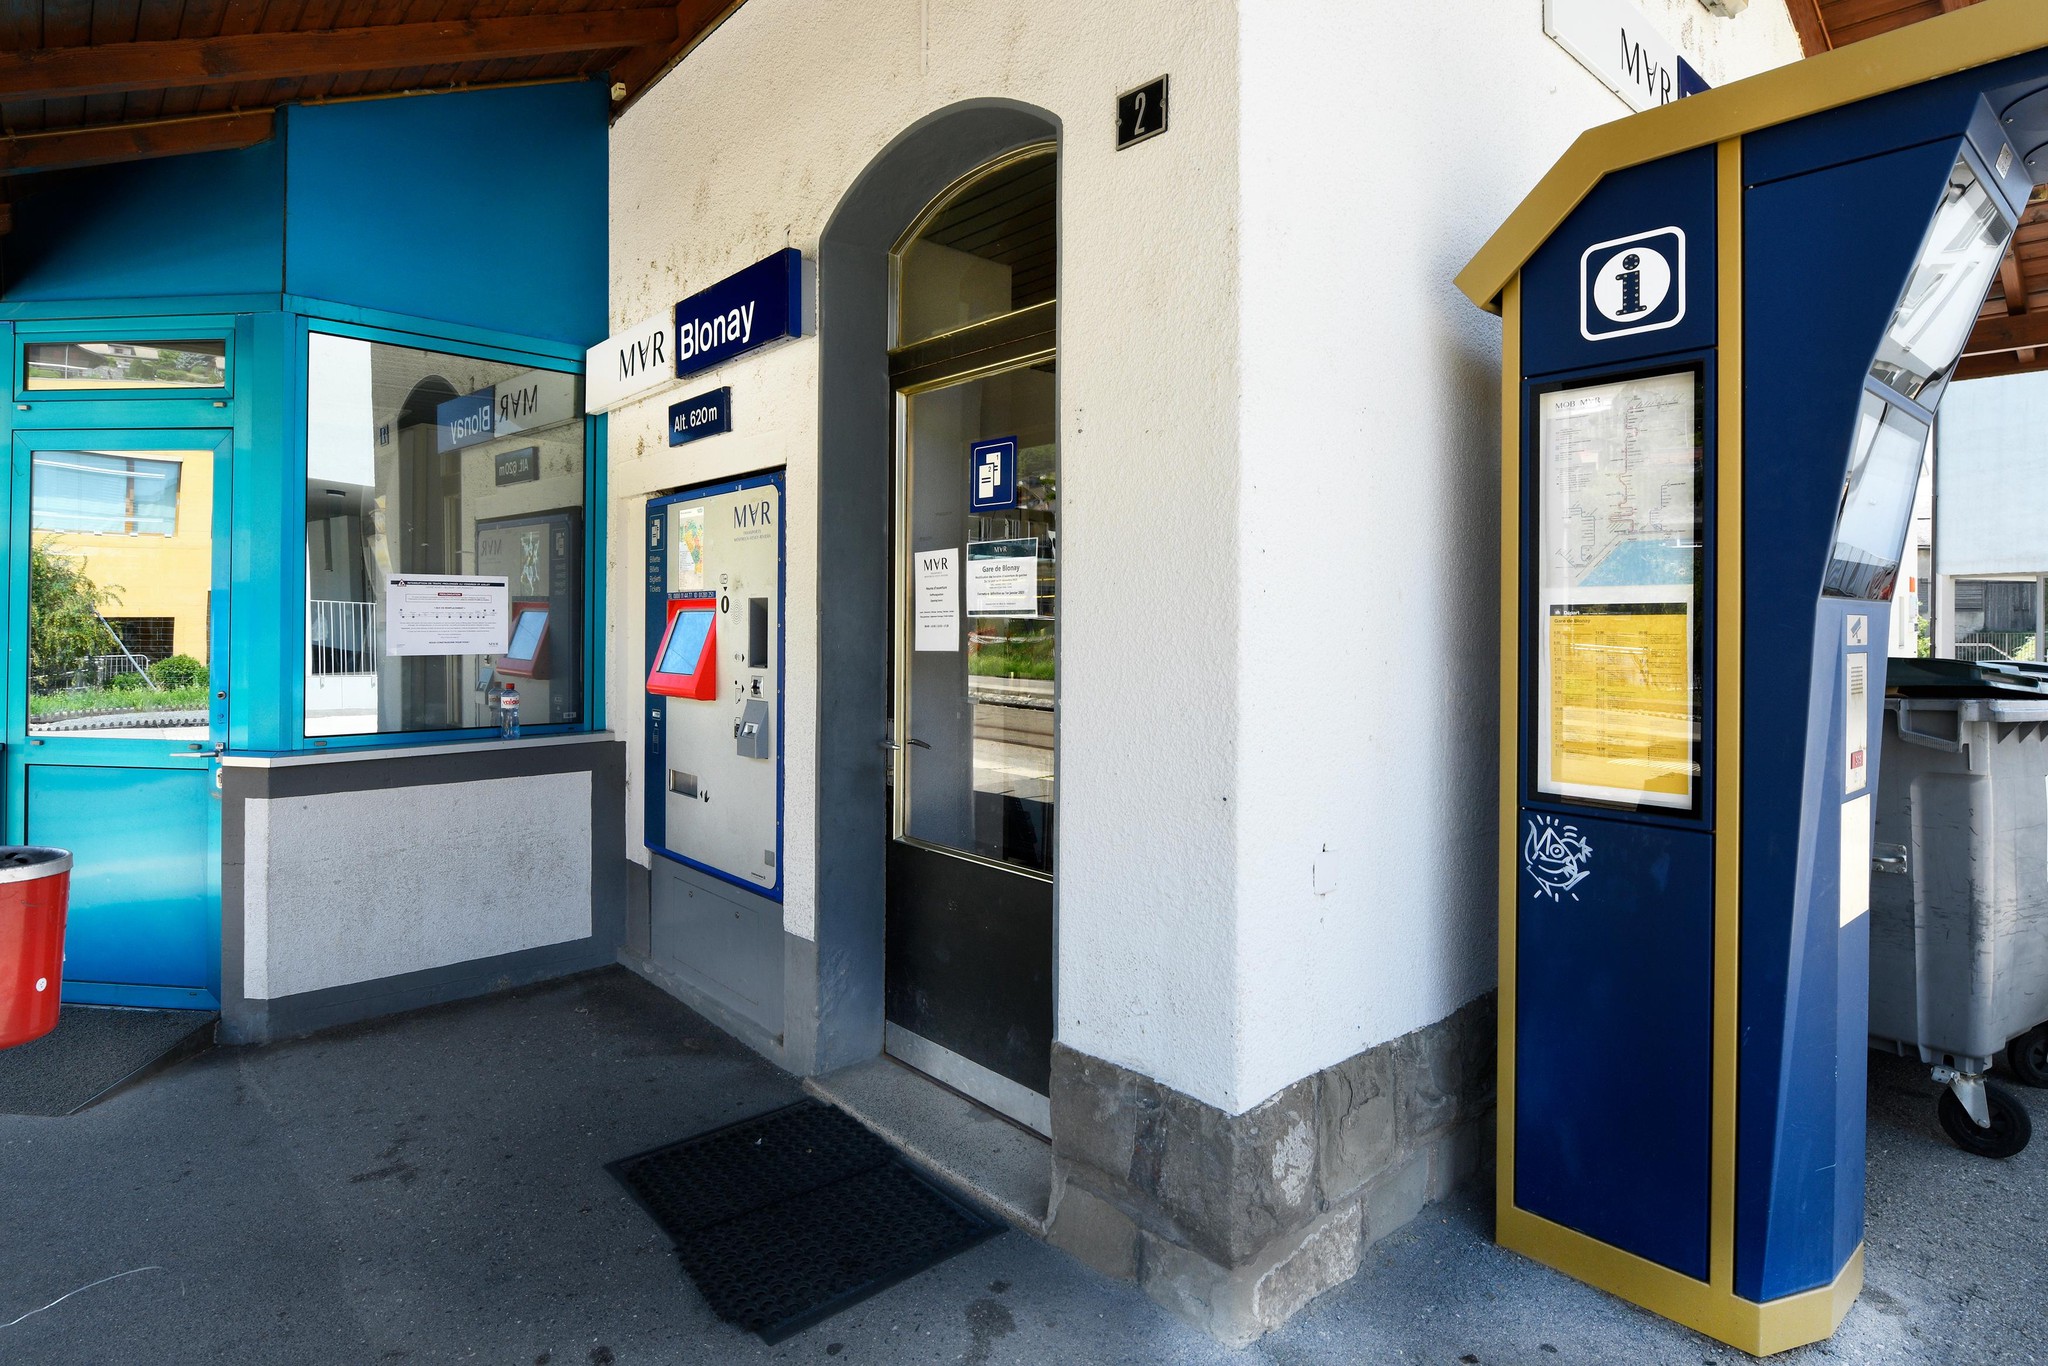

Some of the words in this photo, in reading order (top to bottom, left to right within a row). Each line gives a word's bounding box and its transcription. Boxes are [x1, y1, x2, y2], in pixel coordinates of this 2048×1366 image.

[1134, 91, 1146, 136] 2
[680, 300, 755, 361] Blonay
[1555, 400, 1576, 409] MOB
[673, 415, 688, 433] Alt.
[982, 565, 994, 573] Gare
[1002, 564, 1020, 573] Blonay
